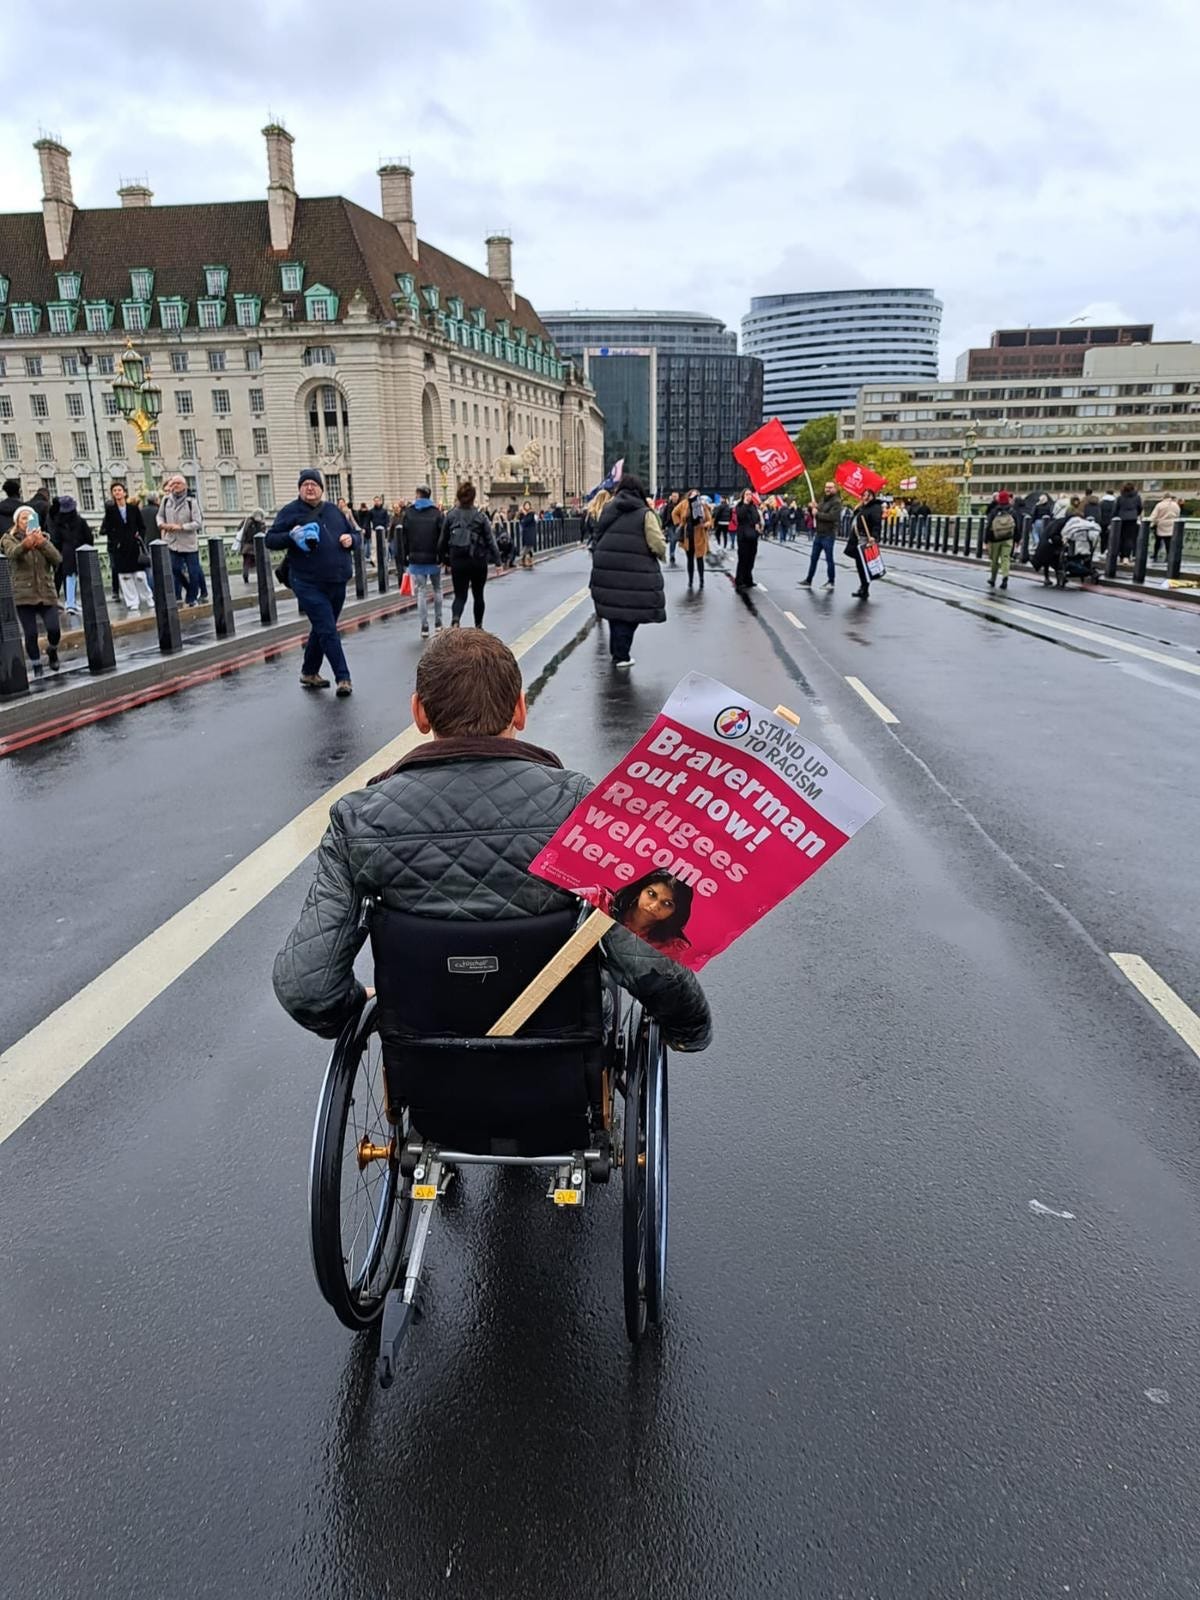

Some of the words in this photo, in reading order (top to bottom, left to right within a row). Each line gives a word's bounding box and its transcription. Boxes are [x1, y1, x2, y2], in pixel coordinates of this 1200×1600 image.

[647, 726, 827, 859] Braverman
[744, 735, 767, 752] TO
[765, 747, 823, 800] RACISM
[754, 719, 806, 760] STAND
[803, 756, 829, 778] UP
[562, 825, 636, 881] here
[584, 805, 719, 897] welcome
[602, 781, 750, 883] Refugees
[626, 761, 689, 796] out
[685, 785, 773, 853] now!
